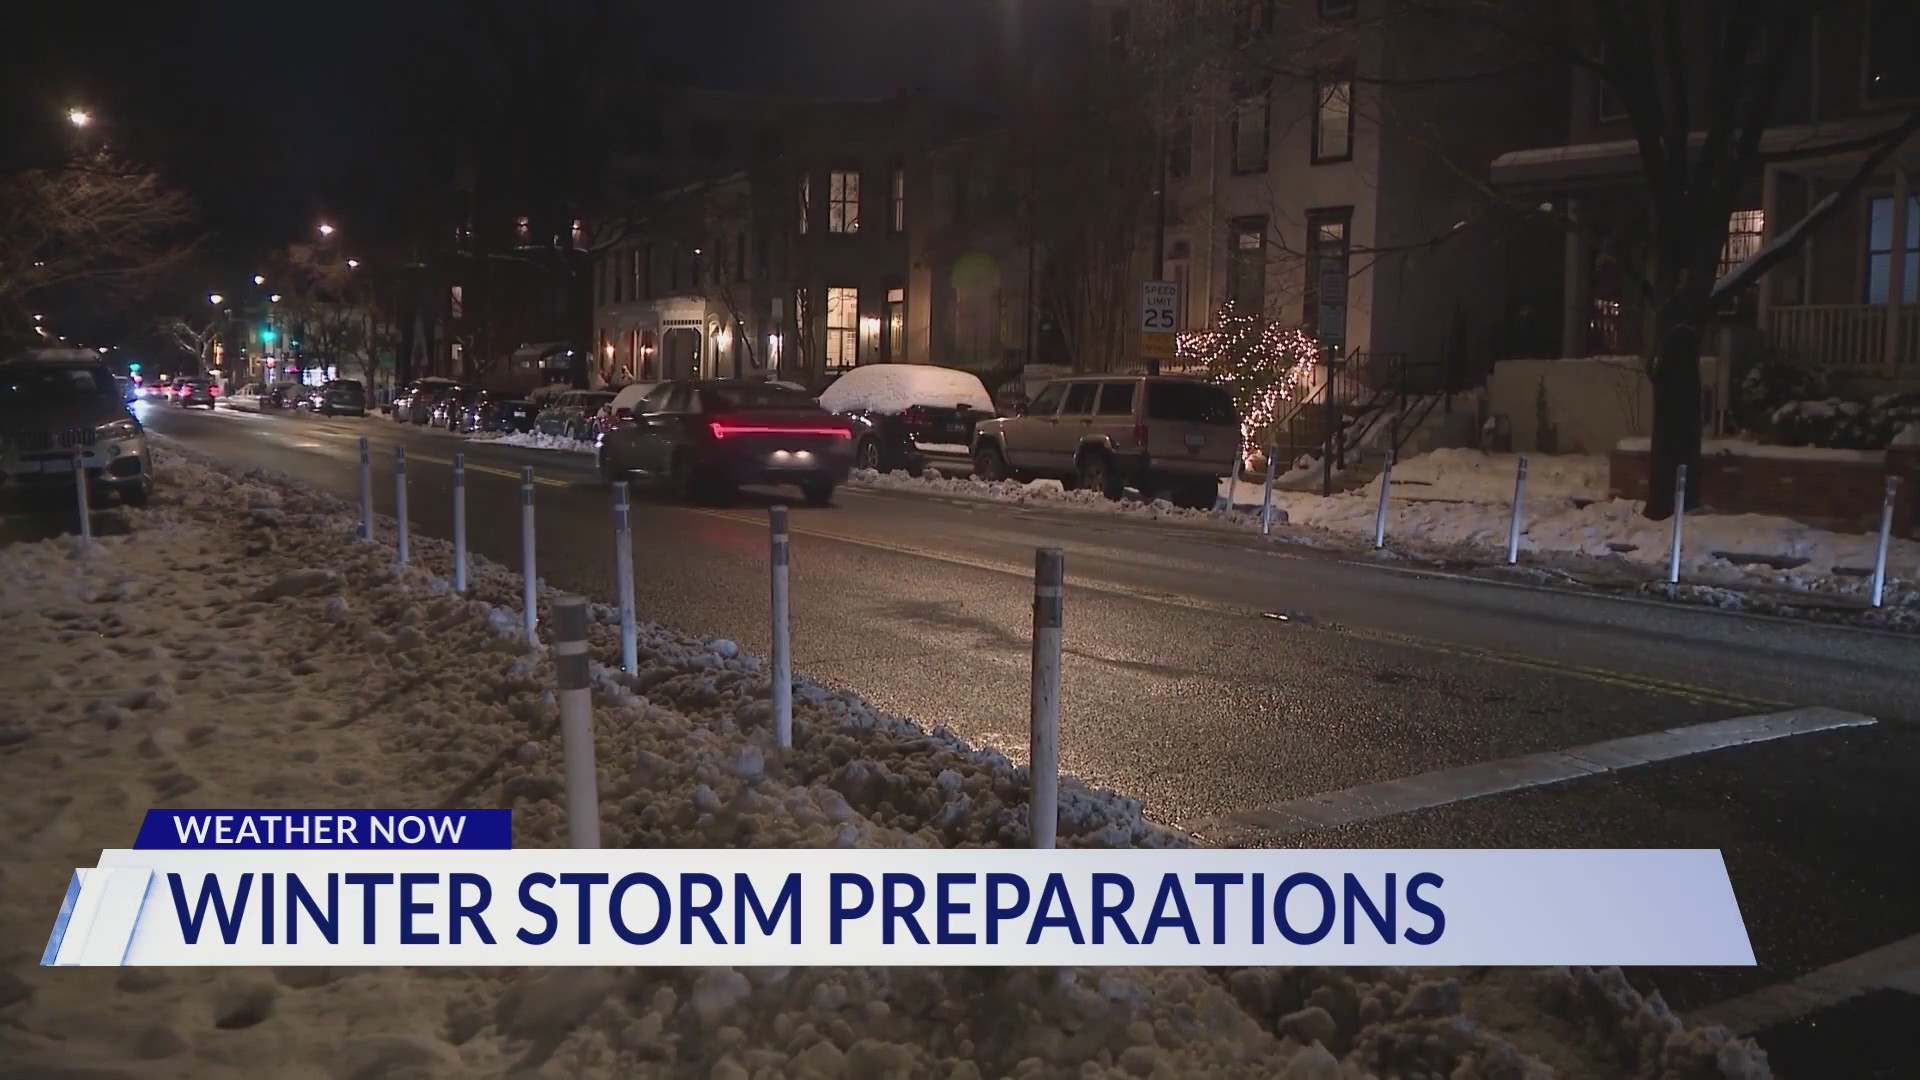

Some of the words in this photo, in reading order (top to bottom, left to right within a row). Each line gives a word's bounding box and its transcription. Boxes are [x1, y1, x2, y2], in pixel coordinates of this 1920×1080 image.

[1145, 285, 1176, 295] SPEED
[1147, 296, 1171, 306] LIMIT
[1144, 309, 1174, 328] 25
